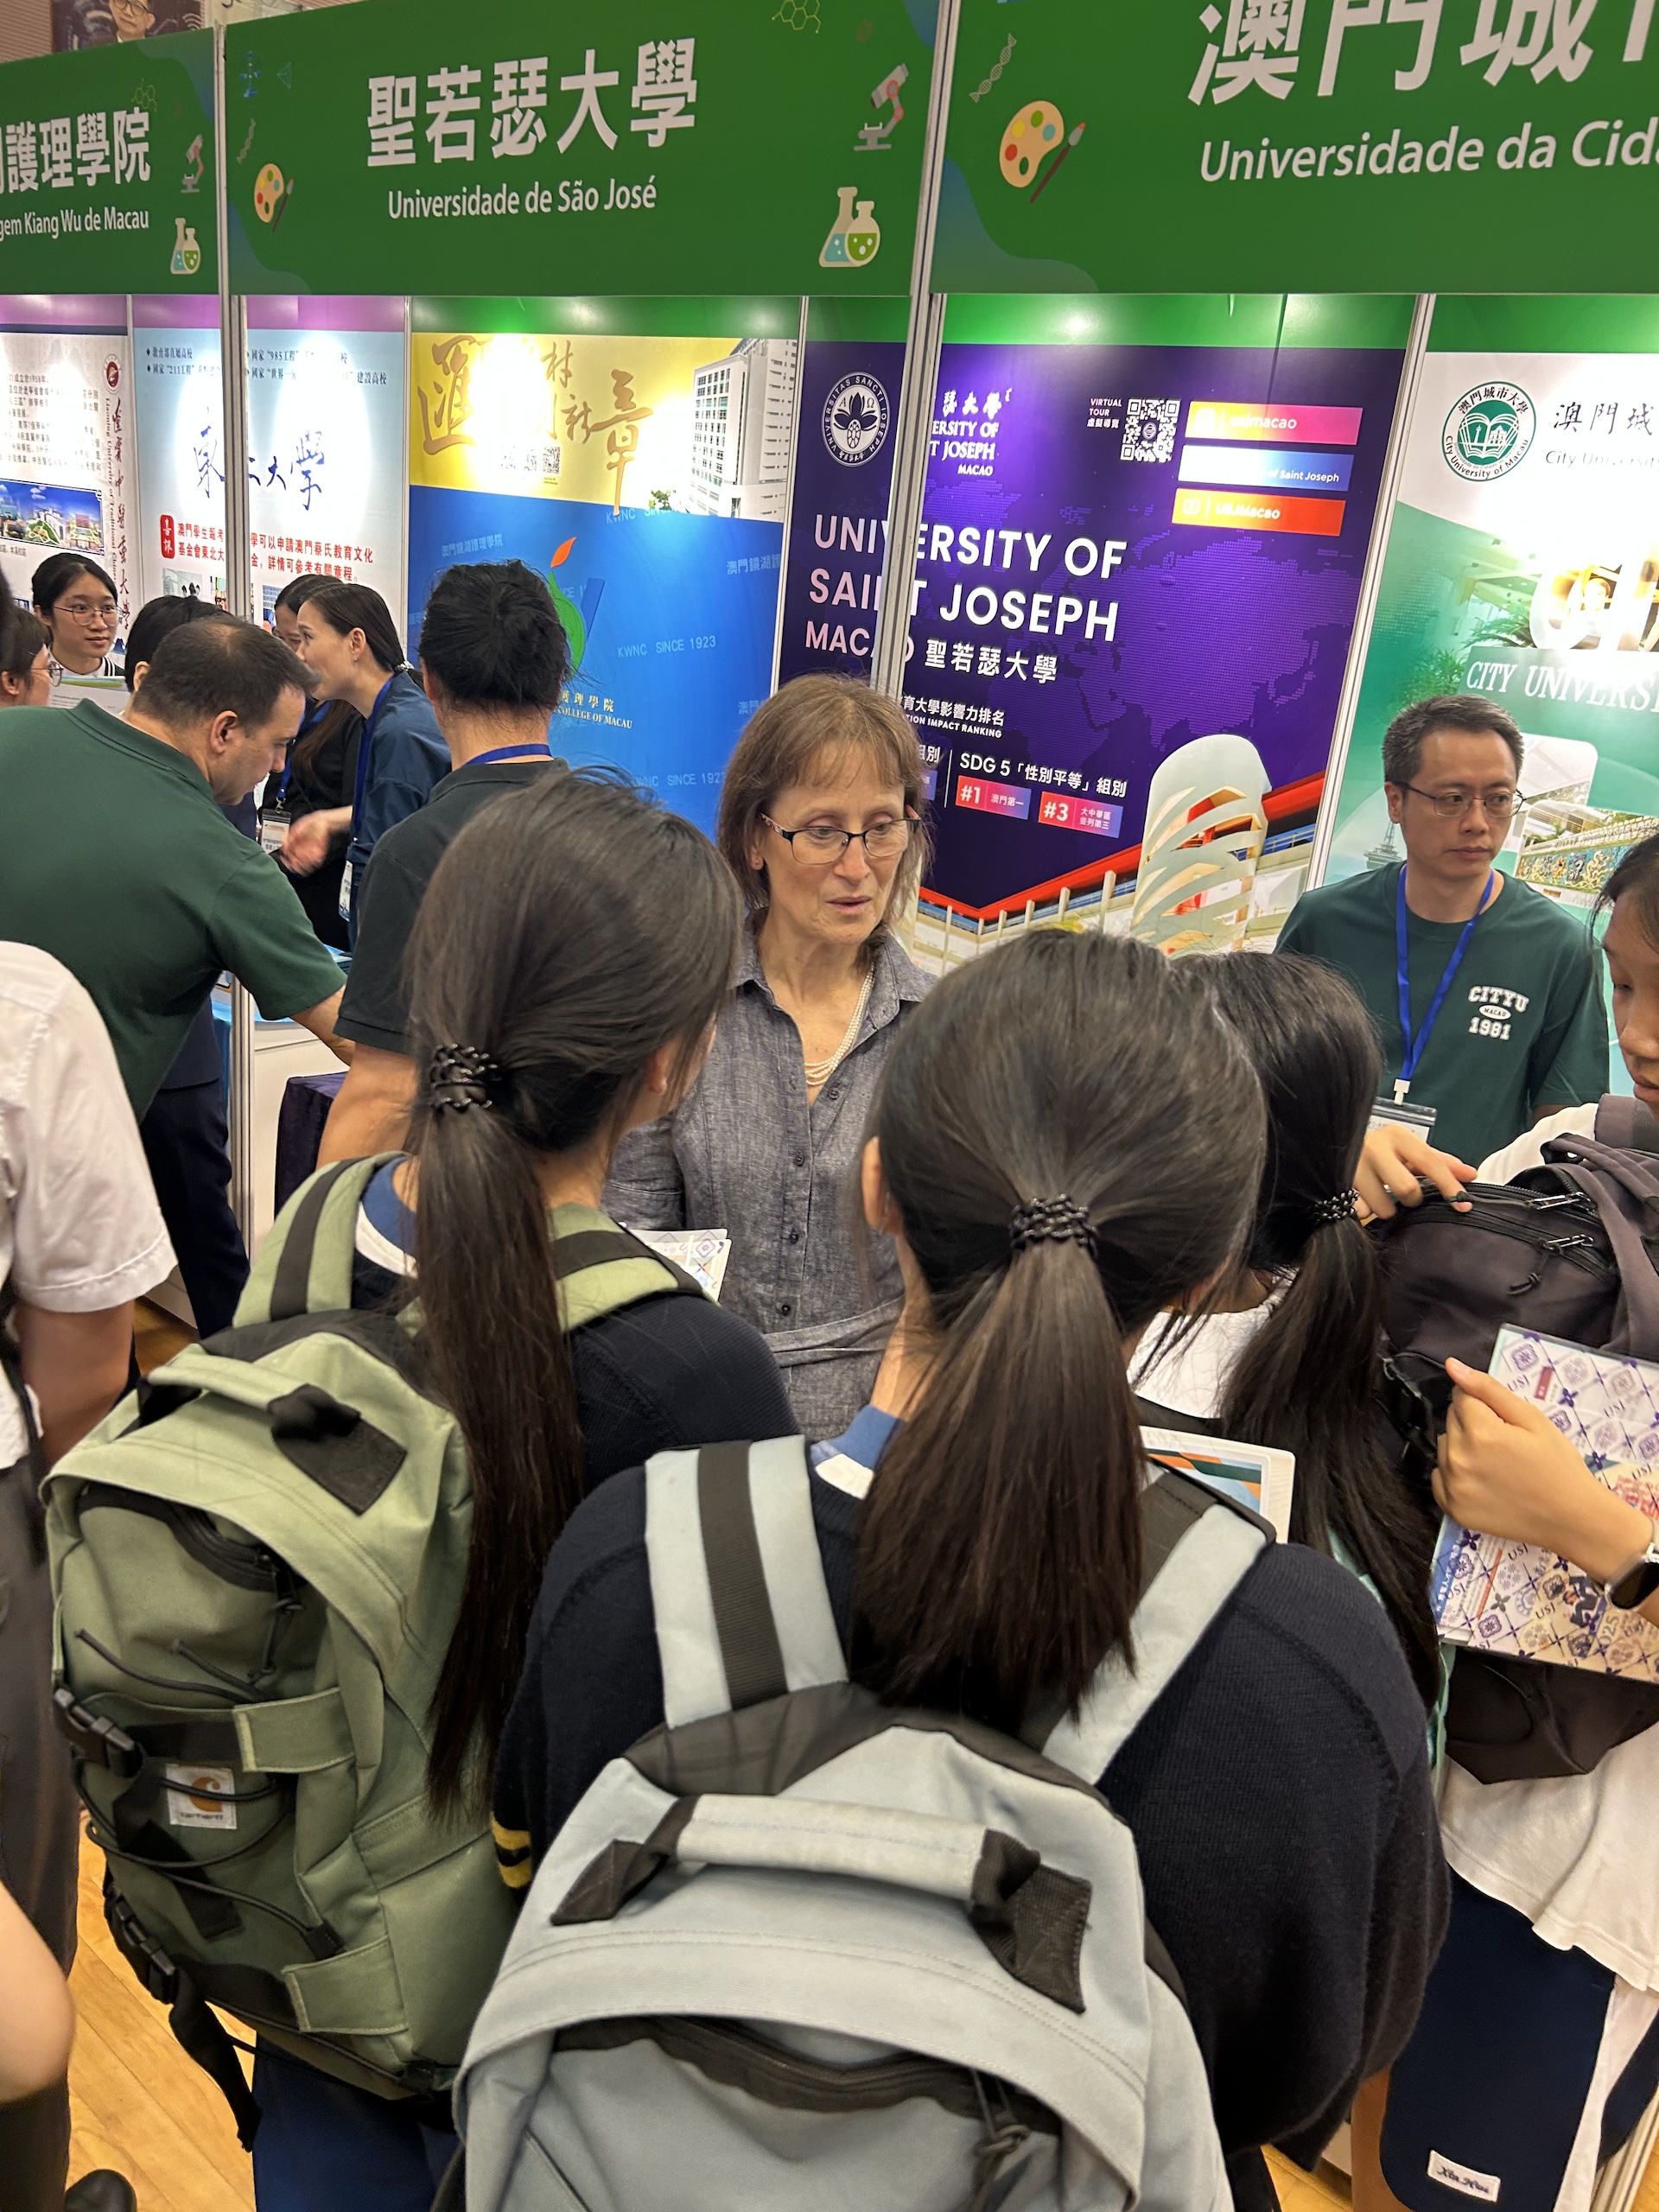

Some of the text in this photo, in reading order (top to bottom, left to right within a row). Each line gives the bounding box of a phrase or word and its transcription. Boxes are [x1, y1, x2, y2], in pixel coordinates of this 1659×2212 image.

[1187, 0, 1659, 105] 澳門城
[367, 37, 697, 167] 聖若瑟大學
[0, 106, 151, 194] 護理學院
[1200, 116, 1659, 182] Universidade da Cid
[388, 175, 658, 219] Universidade de São José
[24, 211, 59, 239] Kiang
[60, 209, 82, 232] Wu
[84, 207, 101, 232] de
[104, 207, 149, 231] Macau
[357, 372, 388, 385] 建設高校
[1089, 408, 1110, 416] TOUR
[1090, 398, 1122, 408] VIRTUAL
[1458, 386, 1529, 415] 澳門城市大學
[931, 419, 1000, 438] ERSITY OF
[941, 440, 996, 461] JOSEPH
[1451, 455, 1491, 480] University
[1494, 466, 1503, 475] of
[1504, 439, 1529, 467] Macau
[957, 464, 994, 476] MACAO
[1279, 469, 1304, 480] Saint
[1305, 472, 1340, 483] Joseph
[1064, 537, 1128, 580] OF
[939, 582, 1119, 643] JOSEPH
[618, 635, 716, 658] KWNC SINCE 1923
[925, 639, 1058, 684] 聖若瑟大學
[1466, 661, 1518, 693] CITY
[593, 713, 604, 723] OF
[605, 715, 633, 729] MACAU
[927, 718, 960, 732] IMPACT
[961, 724, 1002, 739] RANKING
[959, 753, 996, 774] SDG
[1000, 760, 1011, 777] 5
[667, 773, 696, 786] SINCE
[960, 785, 1025, 808] #1 澳門第一
[1043, 802, 1112, 822] #3 大中華區
[1468, 985, 1529, 1013] CITYU
[1483, 1007, 1507, 1017] MACAU
[1468, 1016, 1511, 1040] 1981
